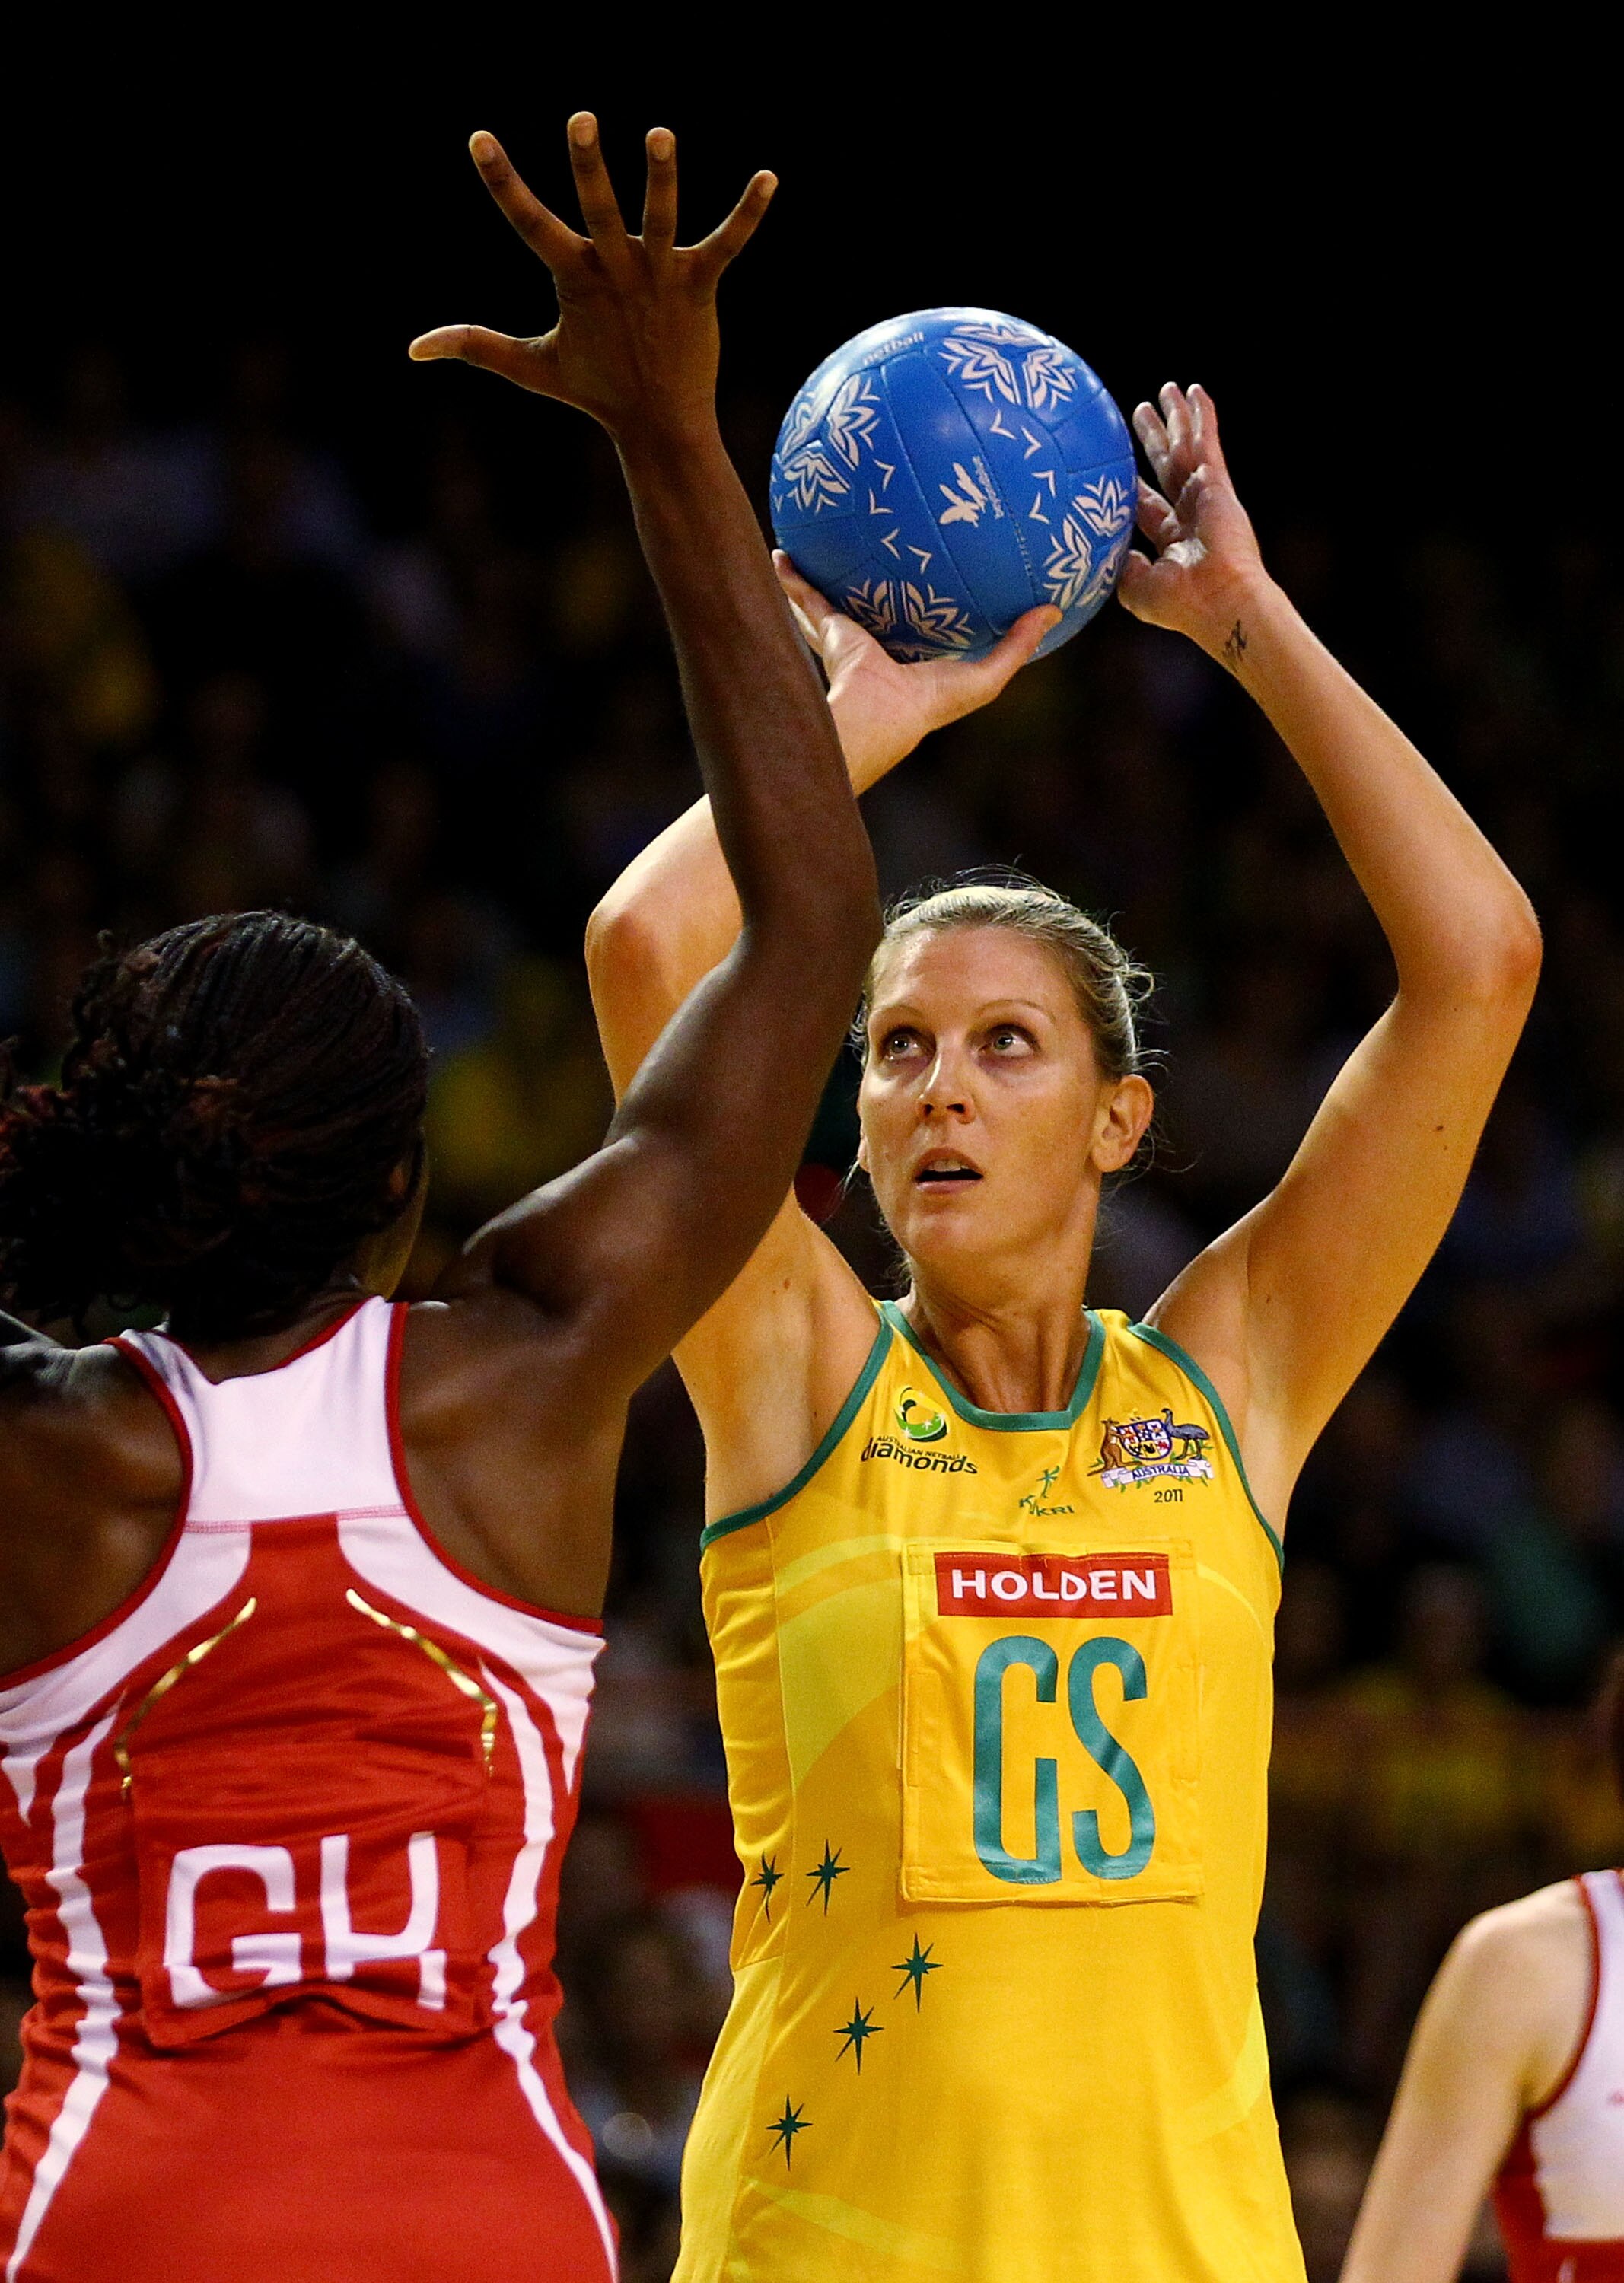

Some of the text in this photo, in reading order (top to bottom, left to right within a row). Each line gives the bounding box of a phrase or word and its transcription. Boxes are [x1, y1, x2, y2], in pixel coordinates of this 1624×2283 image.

[862, 331, 925, 366] netball
[861, 1437, 978, 1474] diamonds
[925, 1450, 960, 1461] NETBALL
[1132, 1463, 1190, 1480] AUSTRALIA
[1154, 1489, 1183, 1503] 2011
[951, 1568, 1157, 1602] HOLDEN
[973, 1635, 1157, 1885] GS
[162, 1829, 447, 2012] GH
